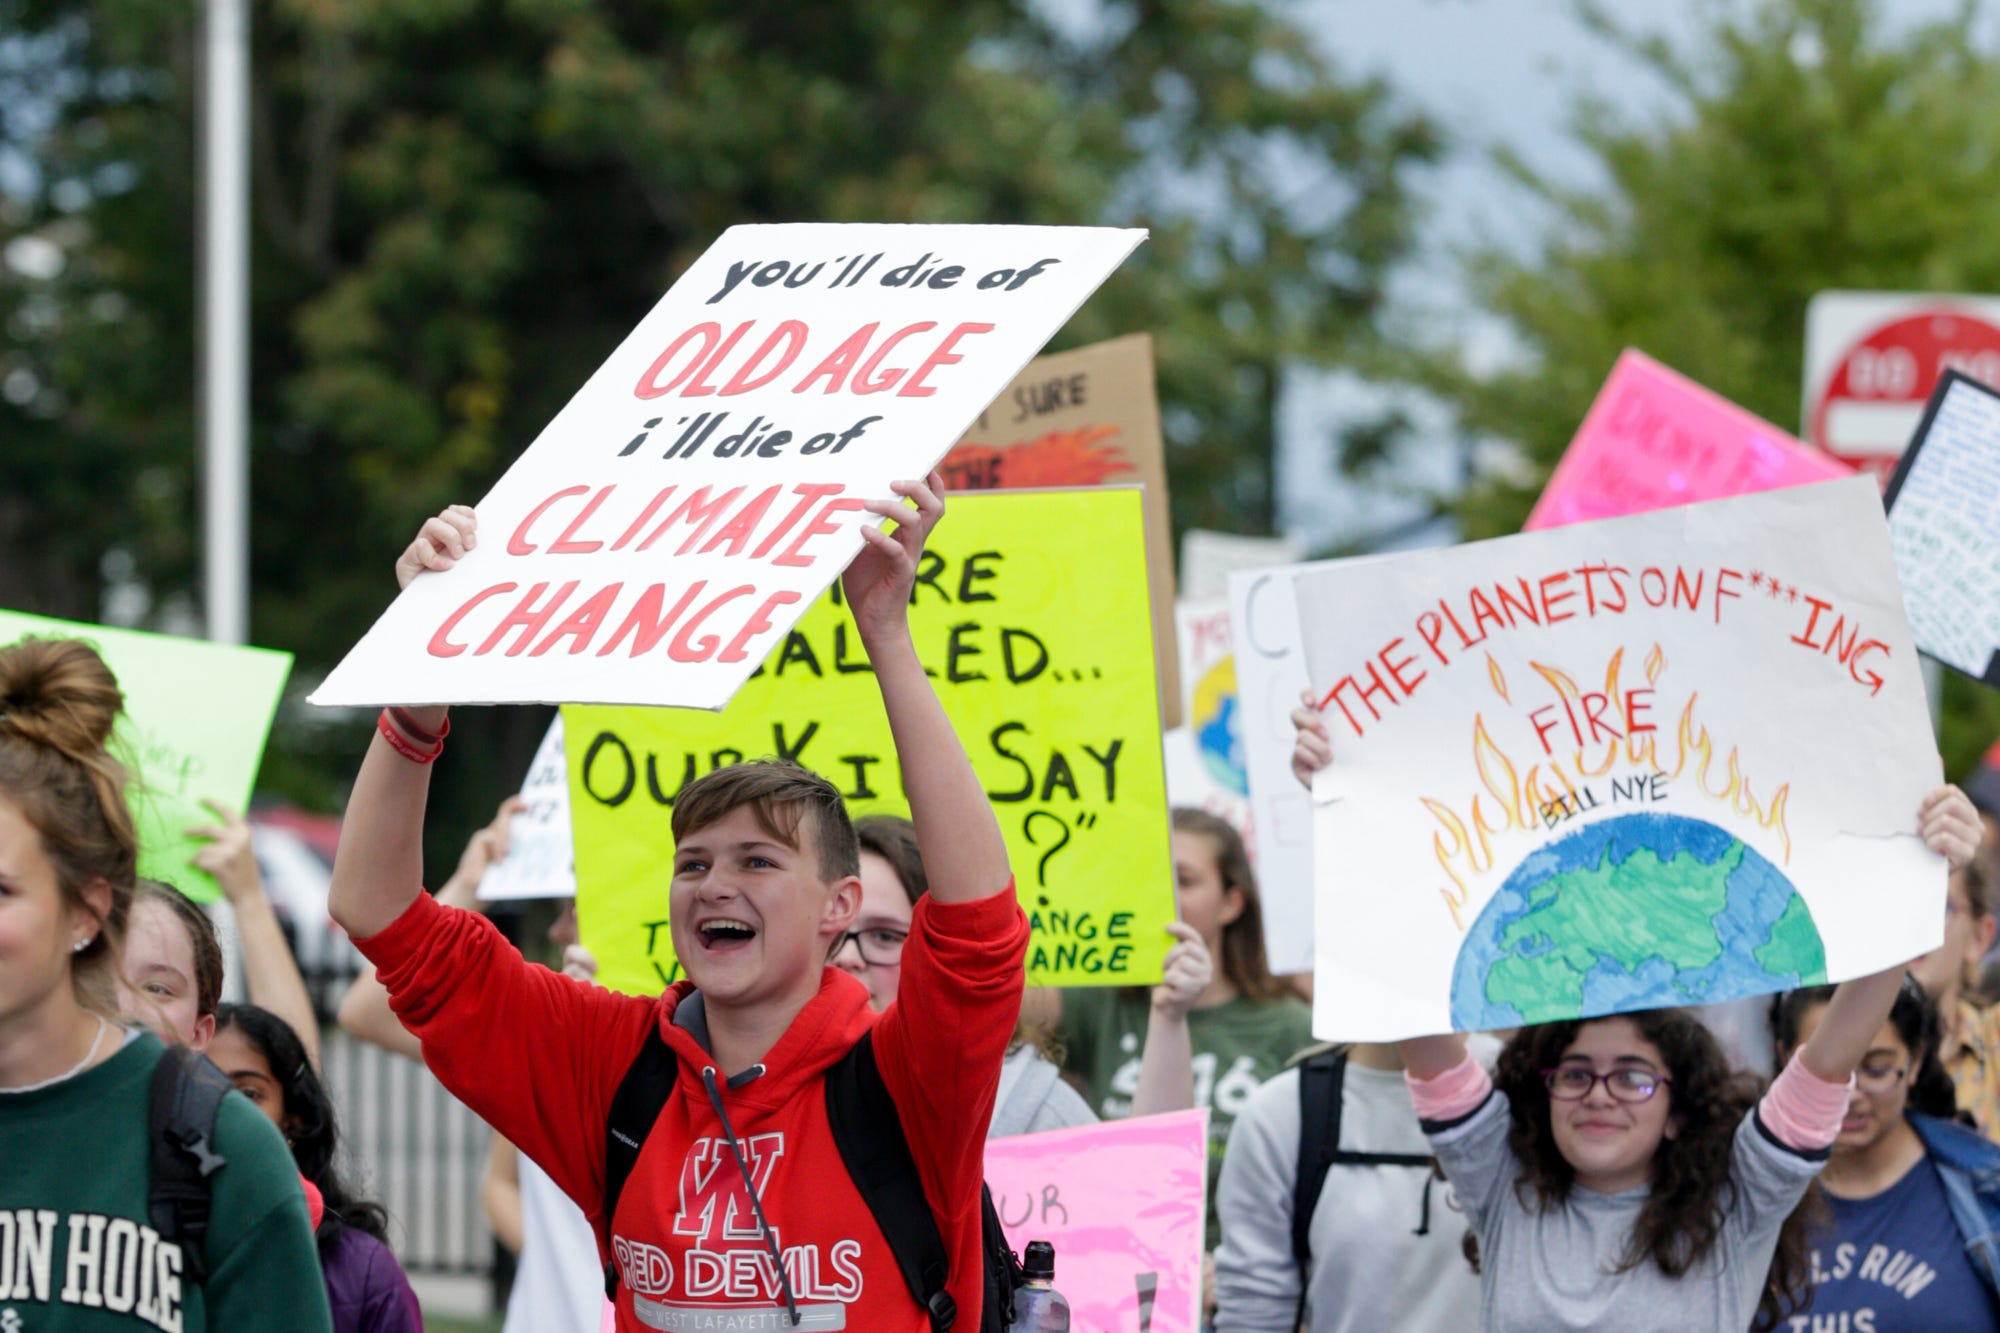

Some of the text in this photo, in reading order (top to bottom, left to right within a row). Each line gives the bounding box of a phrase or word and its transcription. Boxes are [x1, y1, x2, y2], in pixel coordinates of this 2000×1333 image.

[706, 253, 1062, 304] you'll die of
[634, 320, 995, 400] OLD AGE
[1012, 372, 1089, 423] SURE
[713, 416, 793, 458] die
[800, 416, 884, 456] of
[506, 483, 867, 568] CLIMATE
[426, 580, 802, 664] CHANGE
[1317, 638, 1427, 737] THE
[1640, 565, 1703, 611] ON
[747, 622, 1103, 686] ALED...
[1529, 689, 1657, 755] FIRE
[987, 721, 1125, 802] SAY
[1538, 771, 1668, 829] BILL NYE
[1031, 910, 1134, 940] ANGE
[1031, 943, 1134, 973] ANGE
[1000, 1184, 1068, 1228] UR
[61, 1213, 184, 1333] HOLE
[614, 1234, 864, 1303] RED DEVILS
[1858, 1243, 1937, 1301] RUN
[656, 1311, 791, 1330] WEST LAFAYETTE
[1788, 1307, 1876, 1333] THIS
